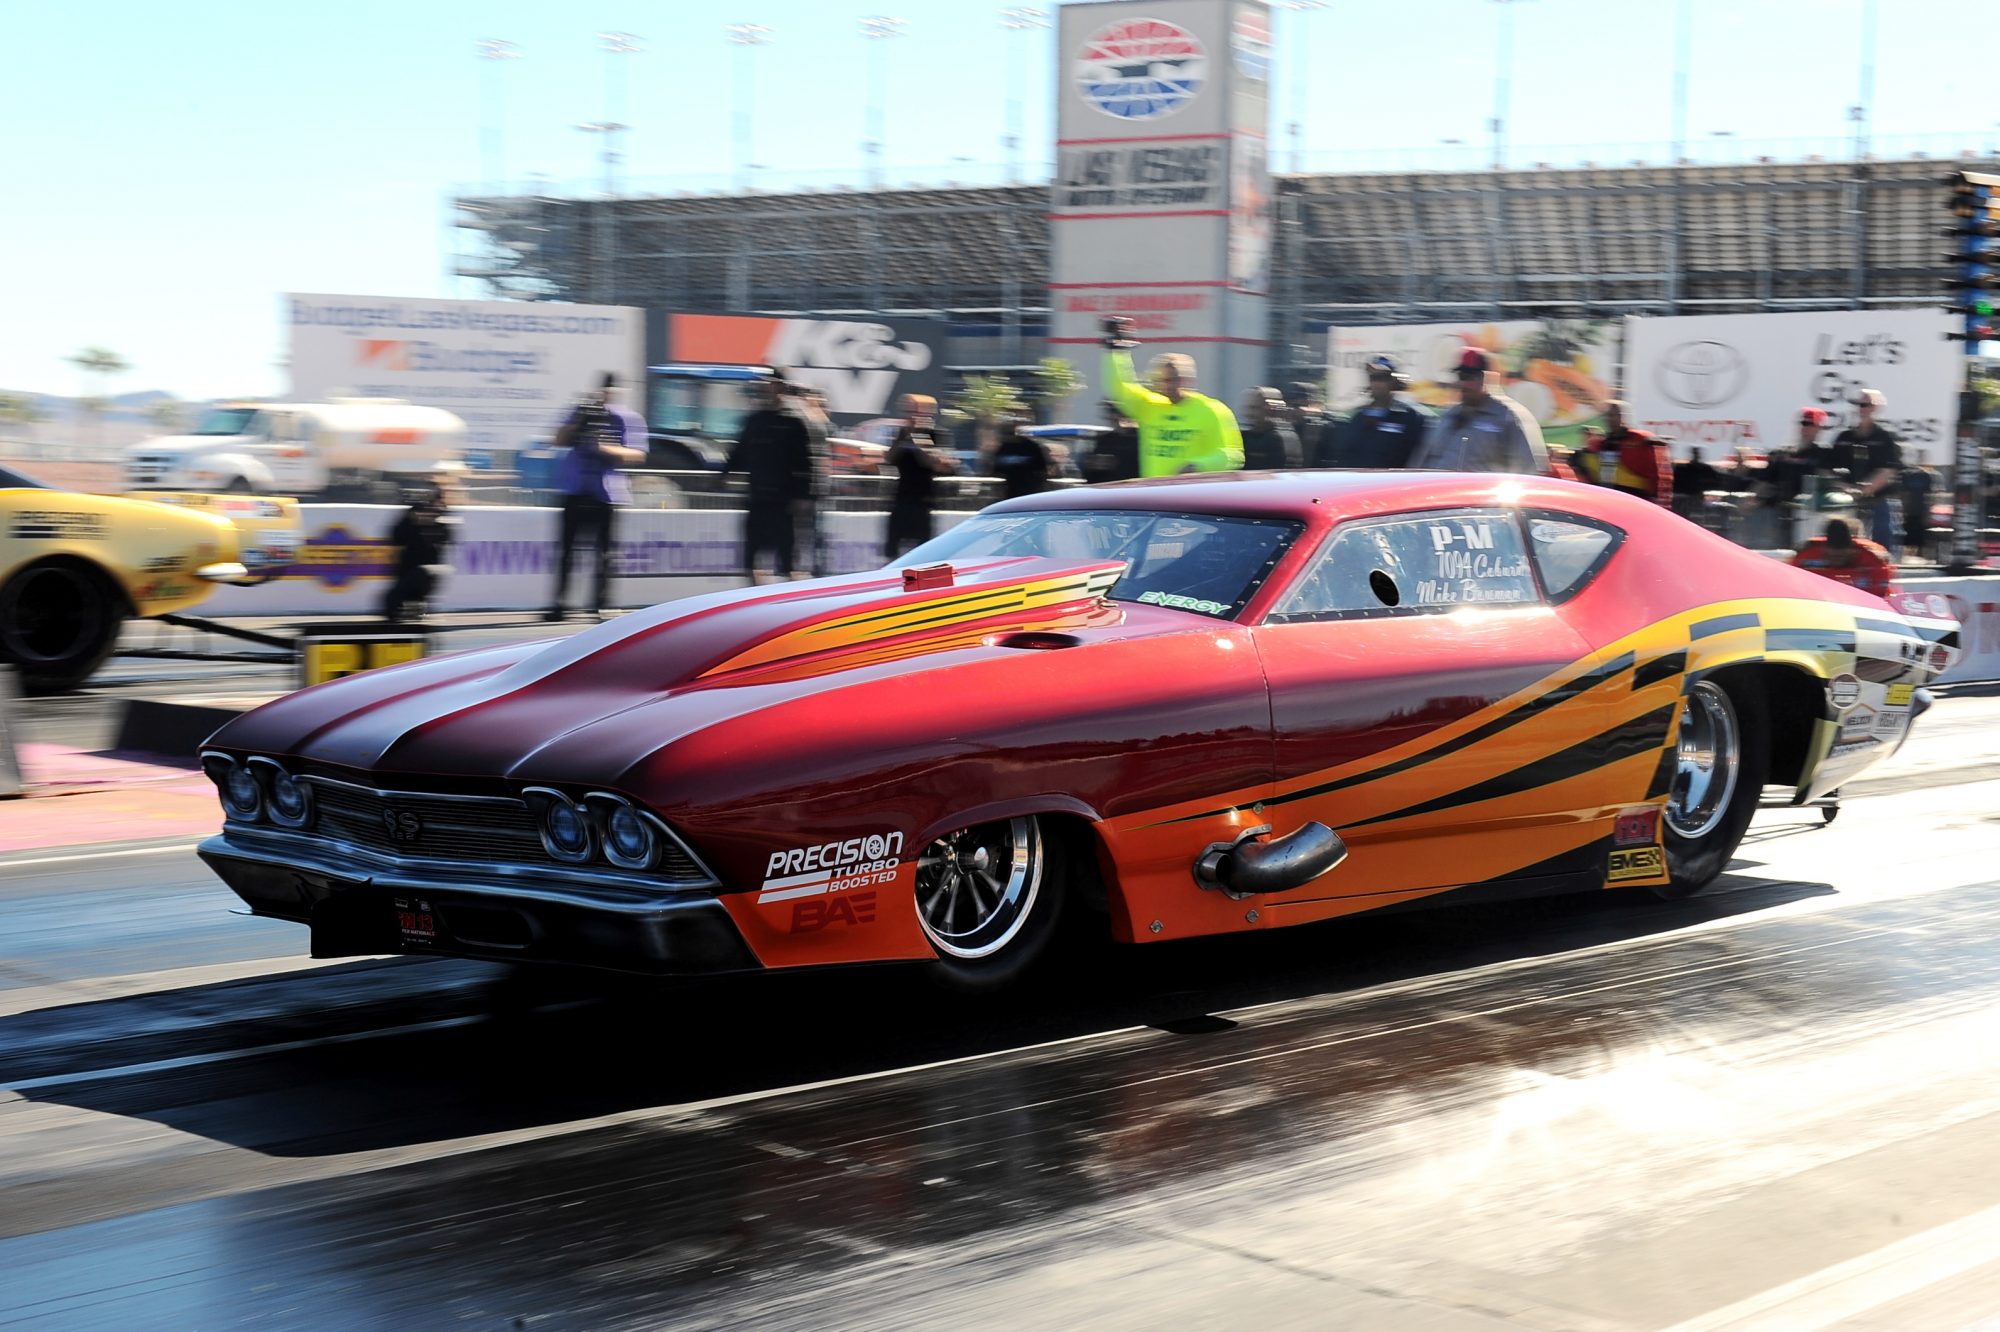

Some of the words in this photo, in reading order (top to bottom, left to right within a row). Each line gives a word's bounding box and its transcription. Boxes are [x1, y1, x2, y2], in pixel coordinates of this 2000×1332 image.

[1812, 333, 1903, 365] Let's
[1137, 591, 1232, 615] ENERGY
[1416, 580, 1457, 603] Mike
[765, 831, 903, 877] PRECISION
[833, 857, 900, 879] TURBO
[829, 870, 897, 892] BOOSTED
[790, 891, 877, 935] BAE
